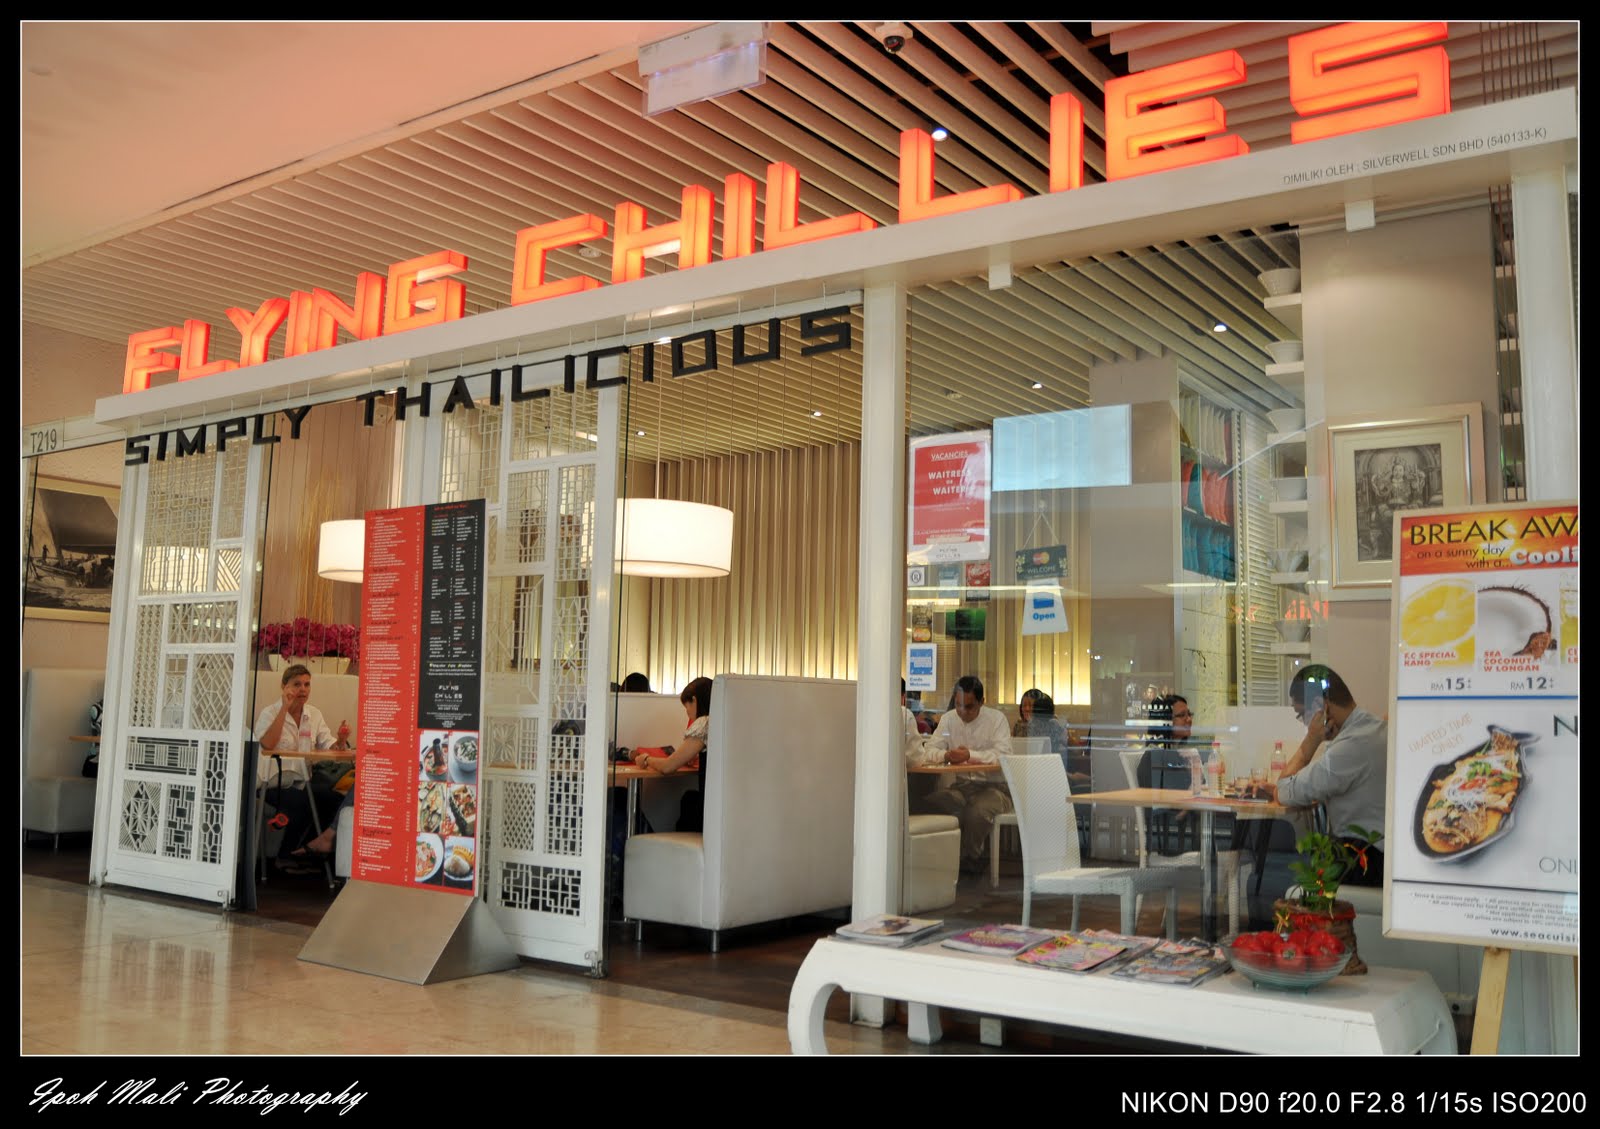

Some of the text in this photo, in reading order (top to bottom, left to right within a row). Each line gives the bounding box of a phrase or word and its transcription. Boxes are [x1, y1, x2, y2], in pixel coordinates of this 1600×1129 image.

[1283, 168, 1324, 186] DIMILIKI
[1325, 163, 1355, 178] OLEH
[1362, 150, 1430, 171] SILVERWELL
[1432, 145, 1456, 158] SDN
[1459, 138, 1484, 152] BHD
[1486, 127, 1548, 150] (540133-K)
[123, 23, 1451, 394] FLYING CHILLIES
[125, 304, 852, 466] SIMPLY THAILICIOUS
[30, 428, 57, 453] T219
[931, 450, 969, 461] VACANCIES
[928, 469, 972, 480] WAITRESS
[1411, 515, 1578, 546] BREAK AW
[1416, 543, 1506, 560] on a sunny day
[1465, 558, 1490, 569] with
[1027, 565, 1056, 574] WELCOME
[1033, 612, 1056, 622] Open
[1419, 650, 1456, 659] SPECIAL
[1484, 657, 1532, 665] COCONUT
[1495, 664, 1540, 672] LONGAN
[1490, 928, 1578, 943] www.seacuisi
